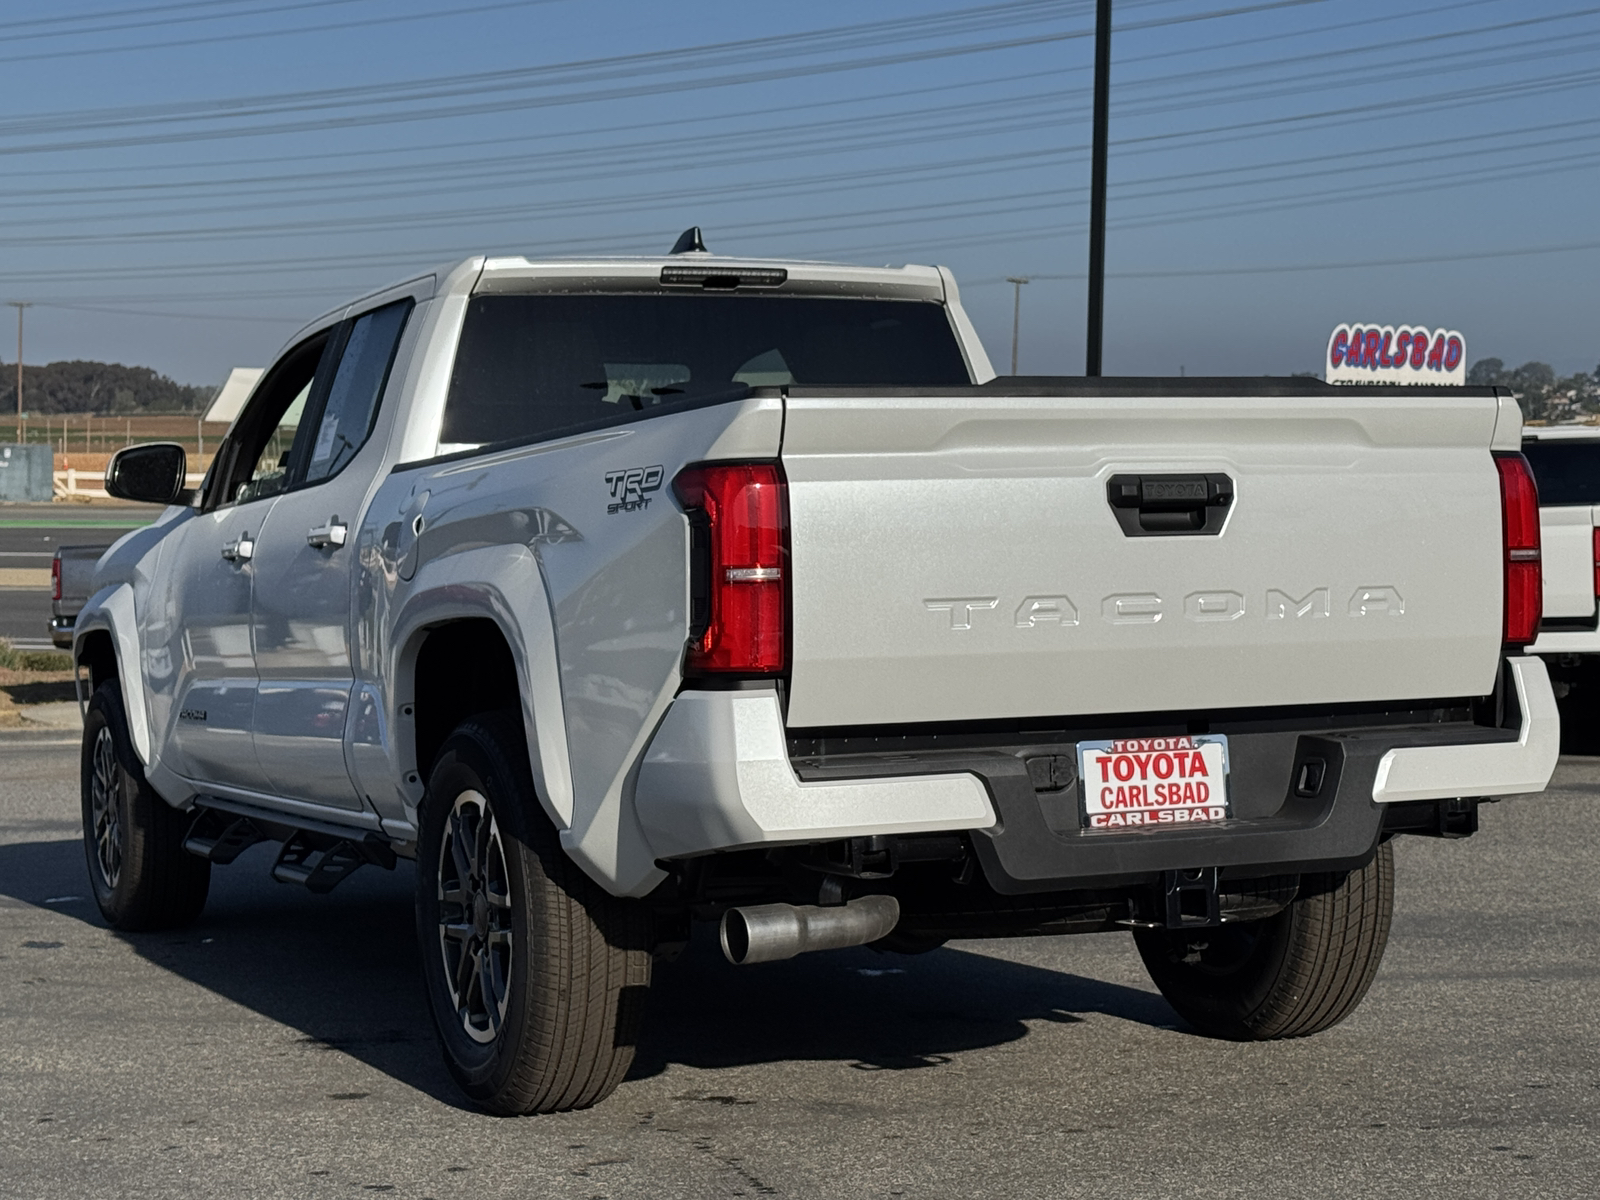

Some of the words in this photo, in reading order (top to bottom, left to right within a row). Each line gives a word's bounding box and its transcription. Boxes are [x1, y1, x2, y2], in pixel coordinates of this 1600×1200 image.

[1331, 328, 1462, 372] CARLSBAD
[605, 464, 664, 502] TRD
[1145, 483, 1204, 496] TOYOTA
[607, 498, 652, 515] SPORT
[922, 585, 1405, 629] TACOMA
[1114, 737, 1191, 753] TOYOTA
[1095, 751, 1209, 783] TOYOTA
[1100, 781, 1210, 810] CARLSBAD
[1090, 807, 1226, 828] CARLSBAD
